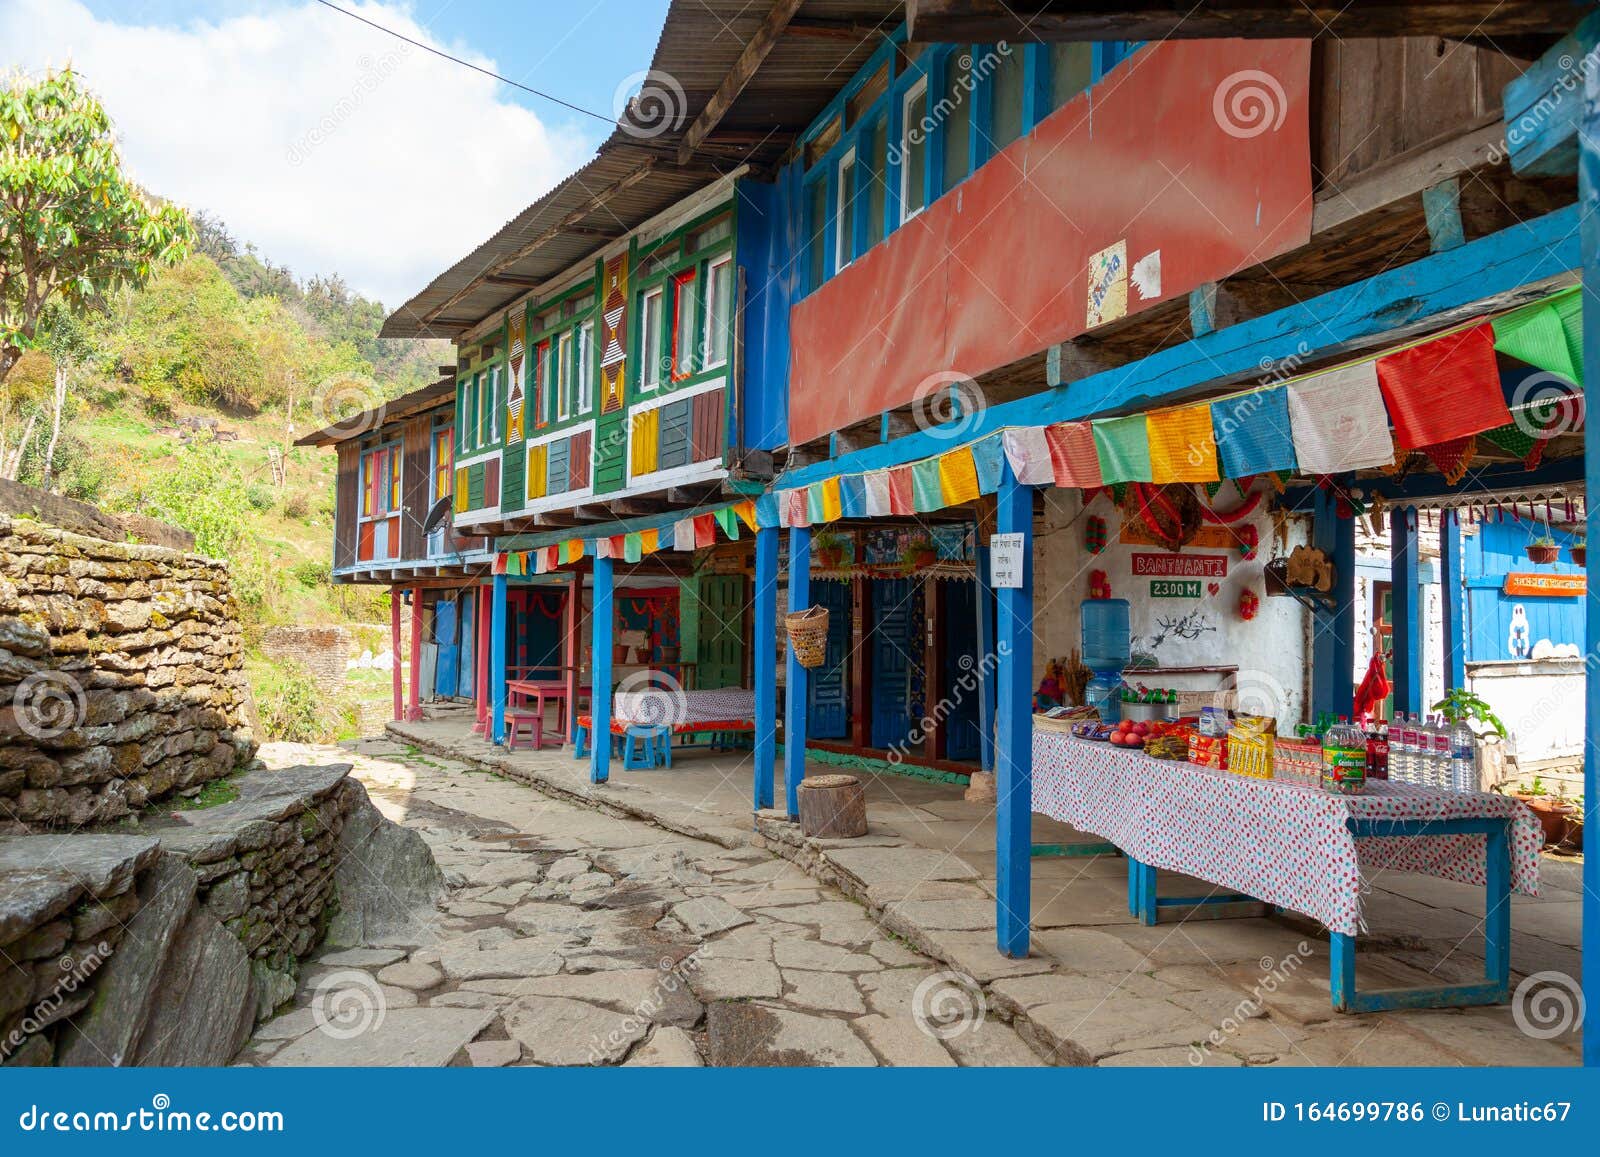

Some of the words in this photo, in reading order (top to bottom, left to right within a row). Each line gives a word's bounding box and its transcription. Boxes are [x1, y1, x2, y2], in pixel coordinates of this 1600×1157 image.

[1136, 556, 1225, 576] BANTHANTI
[1153, 583, 1184, 596] 2300
[1186, 584, 1201, 596] M.
